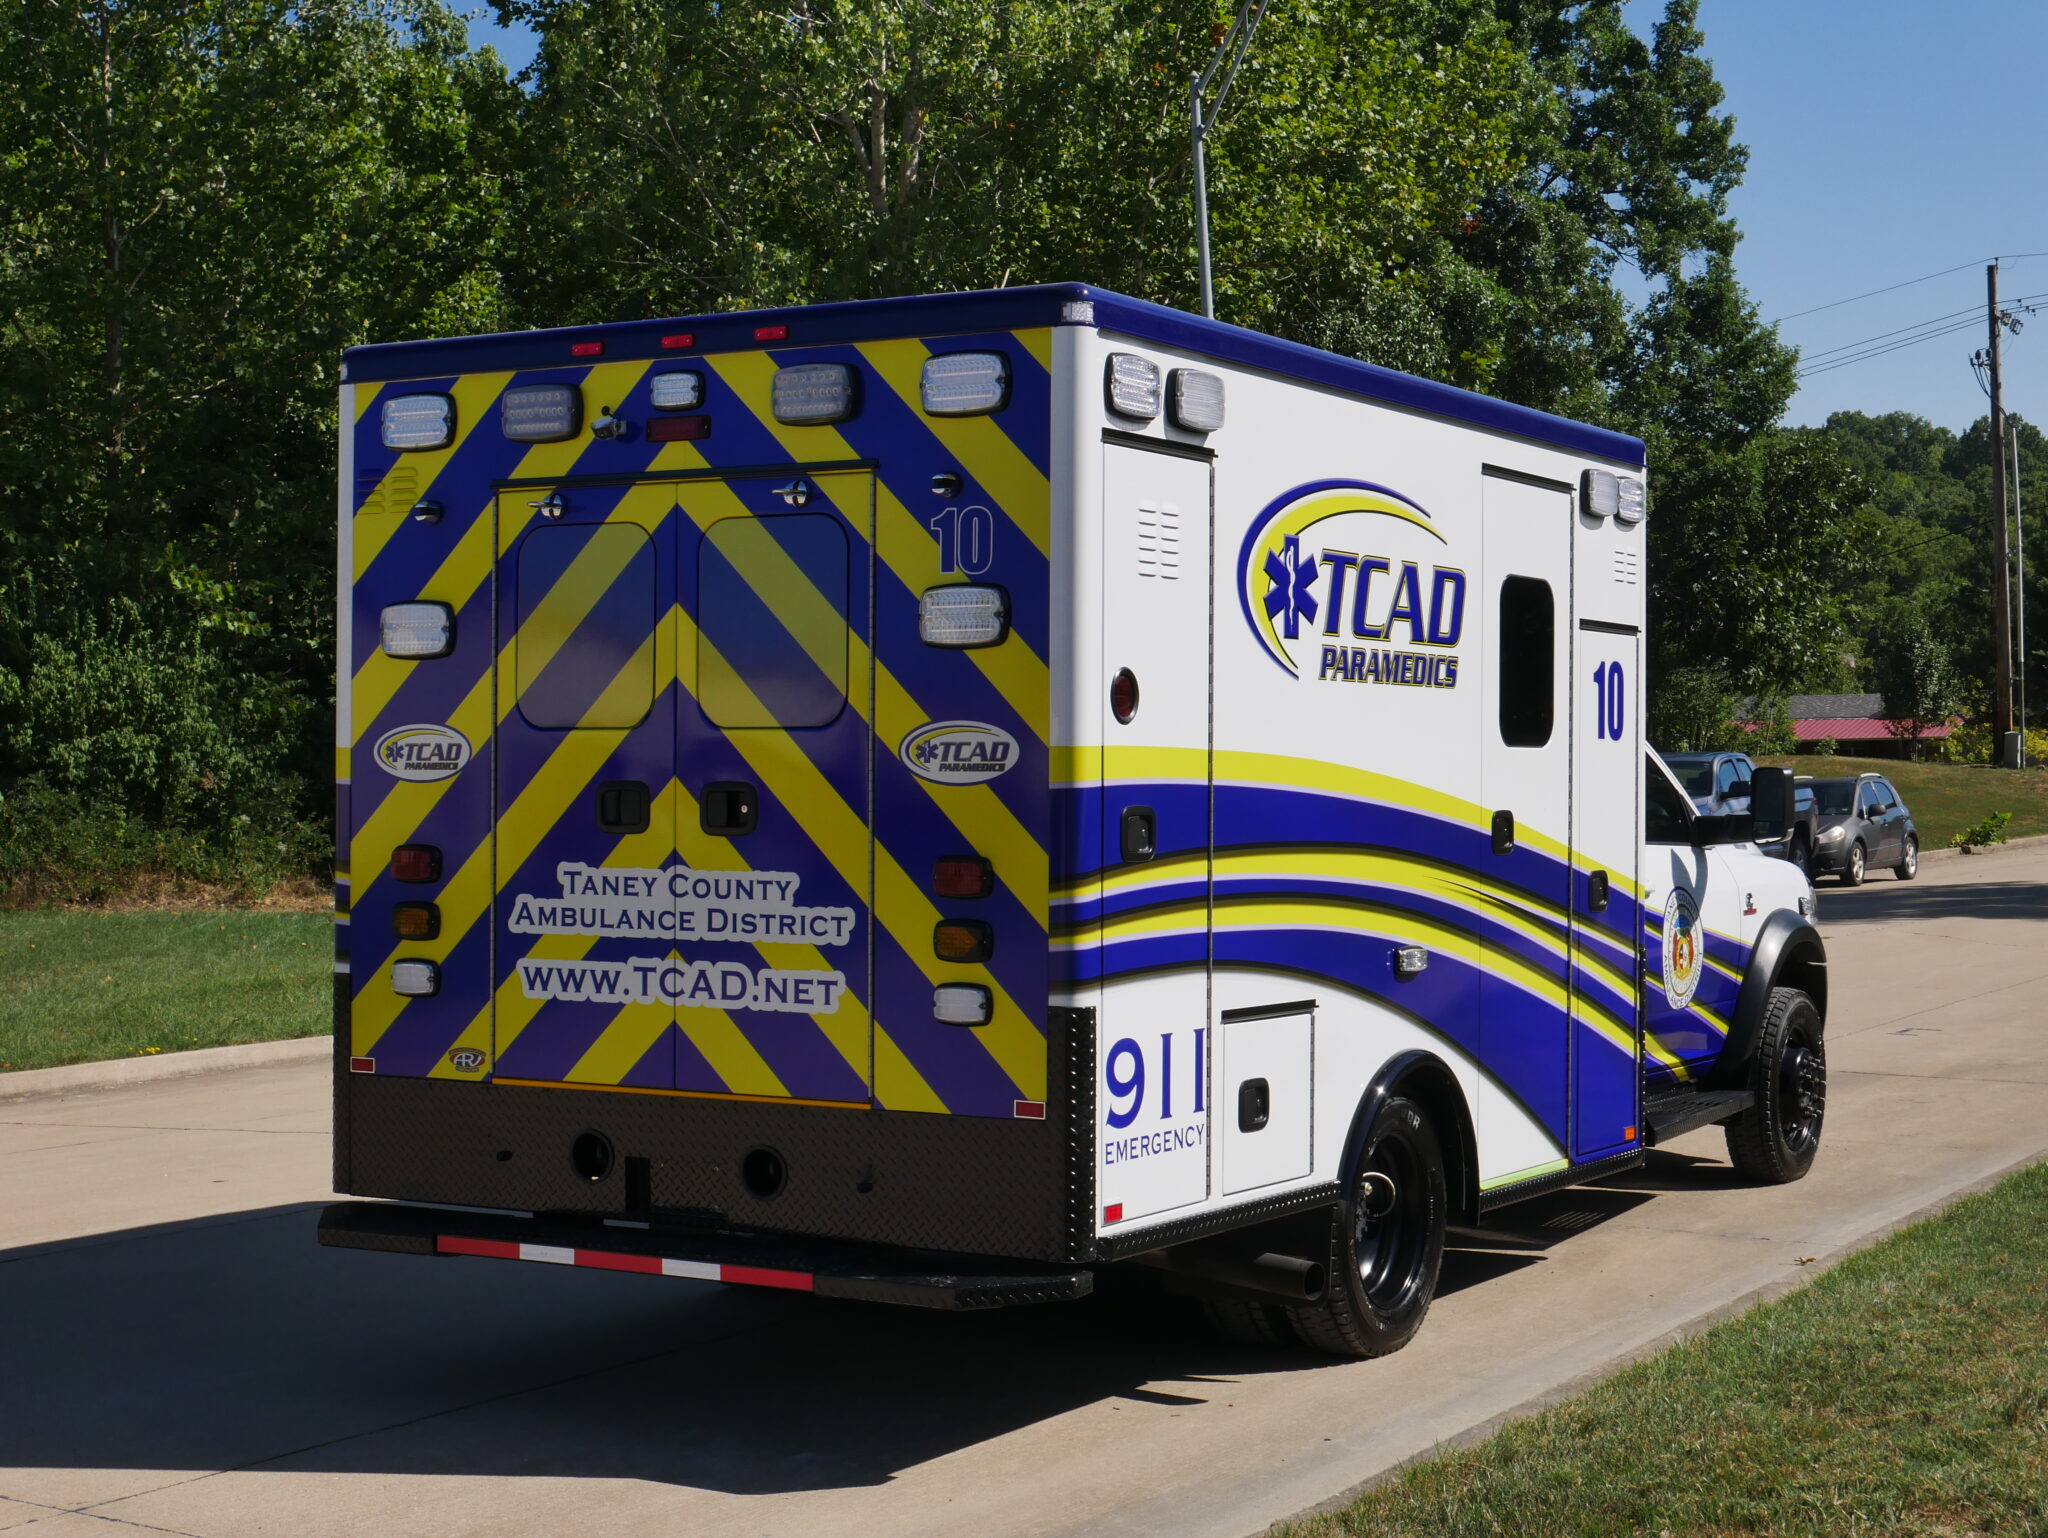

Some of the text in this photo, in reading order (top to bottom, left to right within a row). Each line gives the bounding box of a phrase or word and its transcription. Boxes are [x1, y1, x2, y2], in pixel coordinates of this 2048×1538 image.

[931, 506, 993, 574] 10
[1319, 548, 1467, 648] TCAD
[1318, 644, 1459, 689] PARAMEDICS
[1593, 660, 1625, 742] 10
[404, 742, 463, 763] TCAD
[404, 761, 459, 771] PARAMEDICS
[938, 762, 1006, 773] PARAMEDICS
[940, 741, 1010, 763] TCAD
[563, 870, 793, 901] TANEY COUNTY
[514, 902, 848, 938] AMBULANCE DISTRICT
[1105, 1028, 1205, 1130] 911
[1105, 1123, 1205, 1166] EMERGENCY
